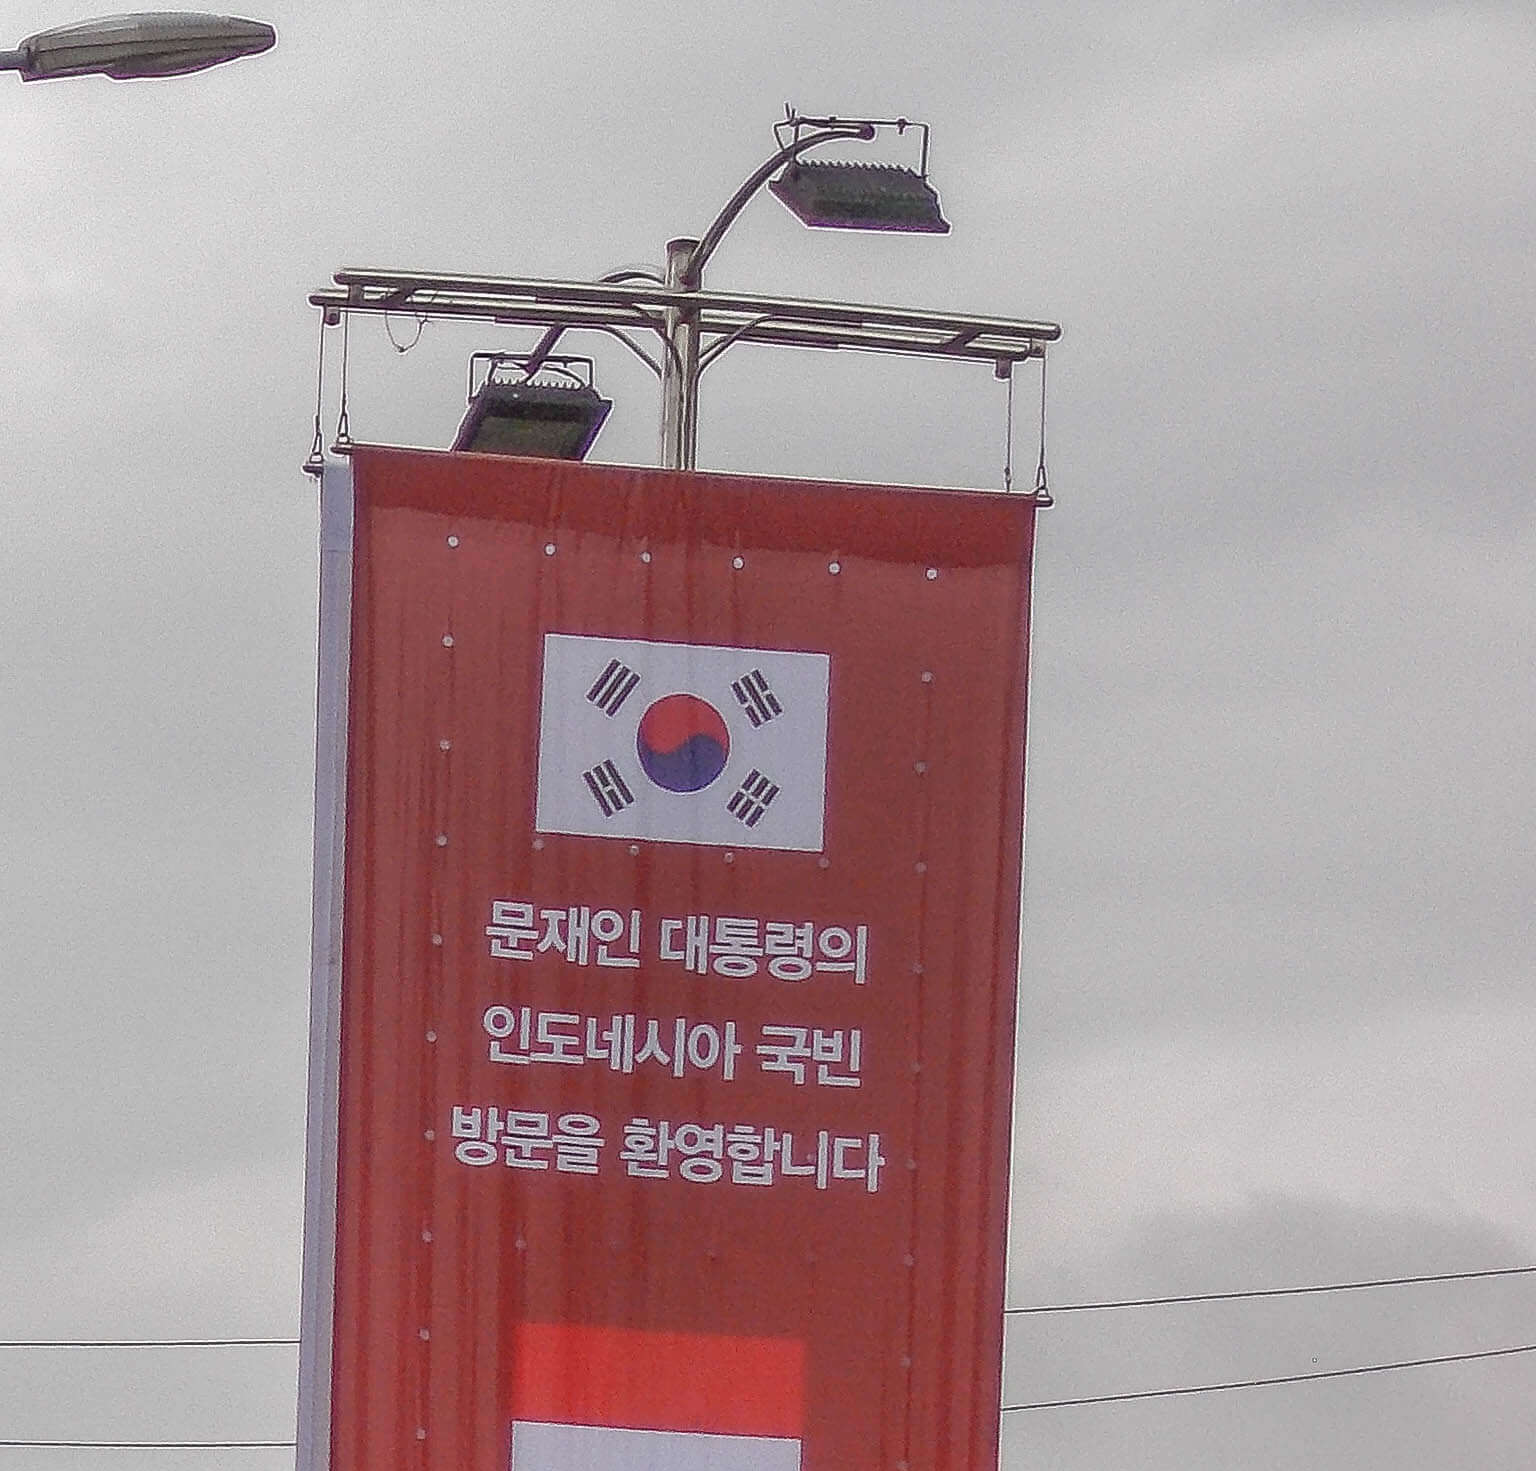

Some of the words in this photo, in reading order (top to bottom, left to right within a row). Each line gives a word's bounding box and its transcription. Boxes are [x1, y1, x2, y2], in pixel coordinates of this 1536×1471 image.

[485, 900, 641, 969] 문재인
[659, 915, 869, 984] 대통령의
[482, 1005, 741, 1080] 인도네시아
[756, 1025, 861, 1088] 국빈
[452, 1104, 605, 1173] 방문을
[619, 1118, 884, 1192] 환영합니다
